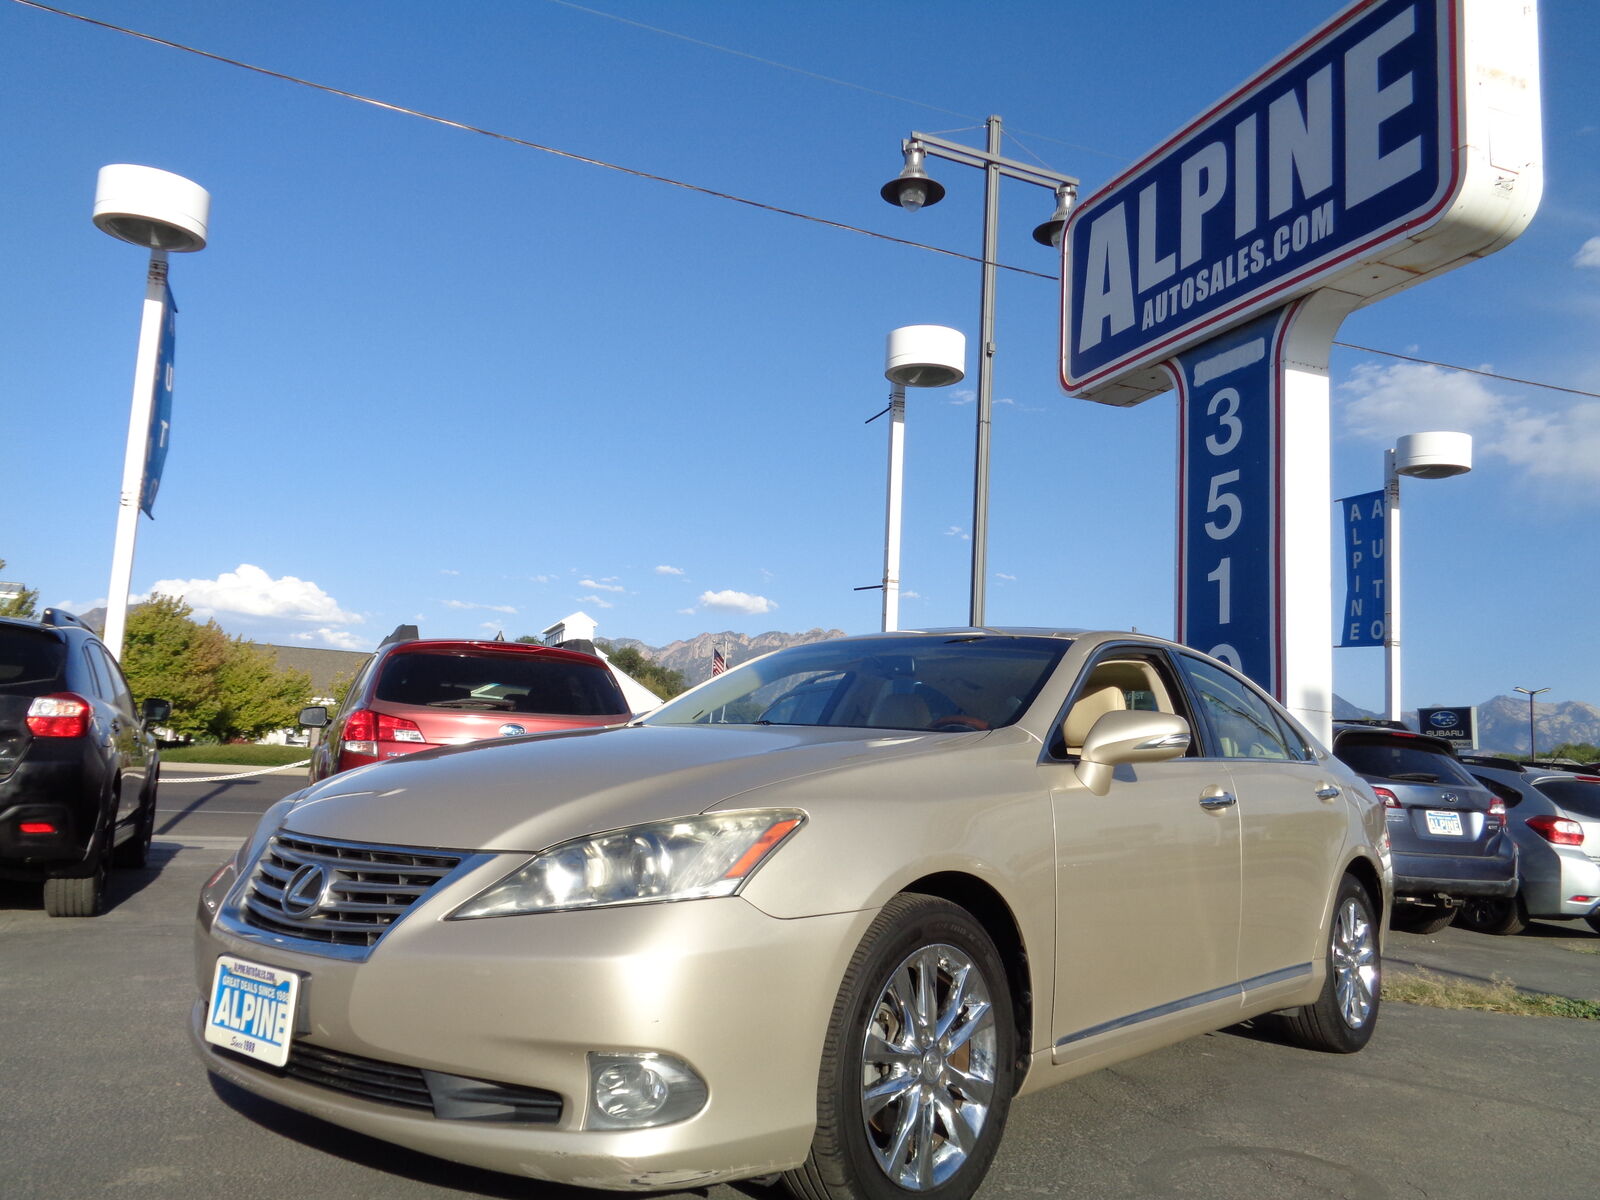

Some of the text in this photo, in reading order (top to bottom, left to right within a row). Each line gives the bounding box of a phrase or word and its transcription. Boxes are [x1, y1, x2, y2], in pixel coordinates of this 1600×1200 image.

[1079, 4, 1421, 354] ALPINE
[1141, 200, 1334, 331] AUTOSALES.COM
[1350, 503, 1363, 641] ALPINE
[1370, 499, 1384, 640] AUTO
[1426, 729, 1464, 737] SUBARU
[214, 987, 289, 1045] ALPINE
